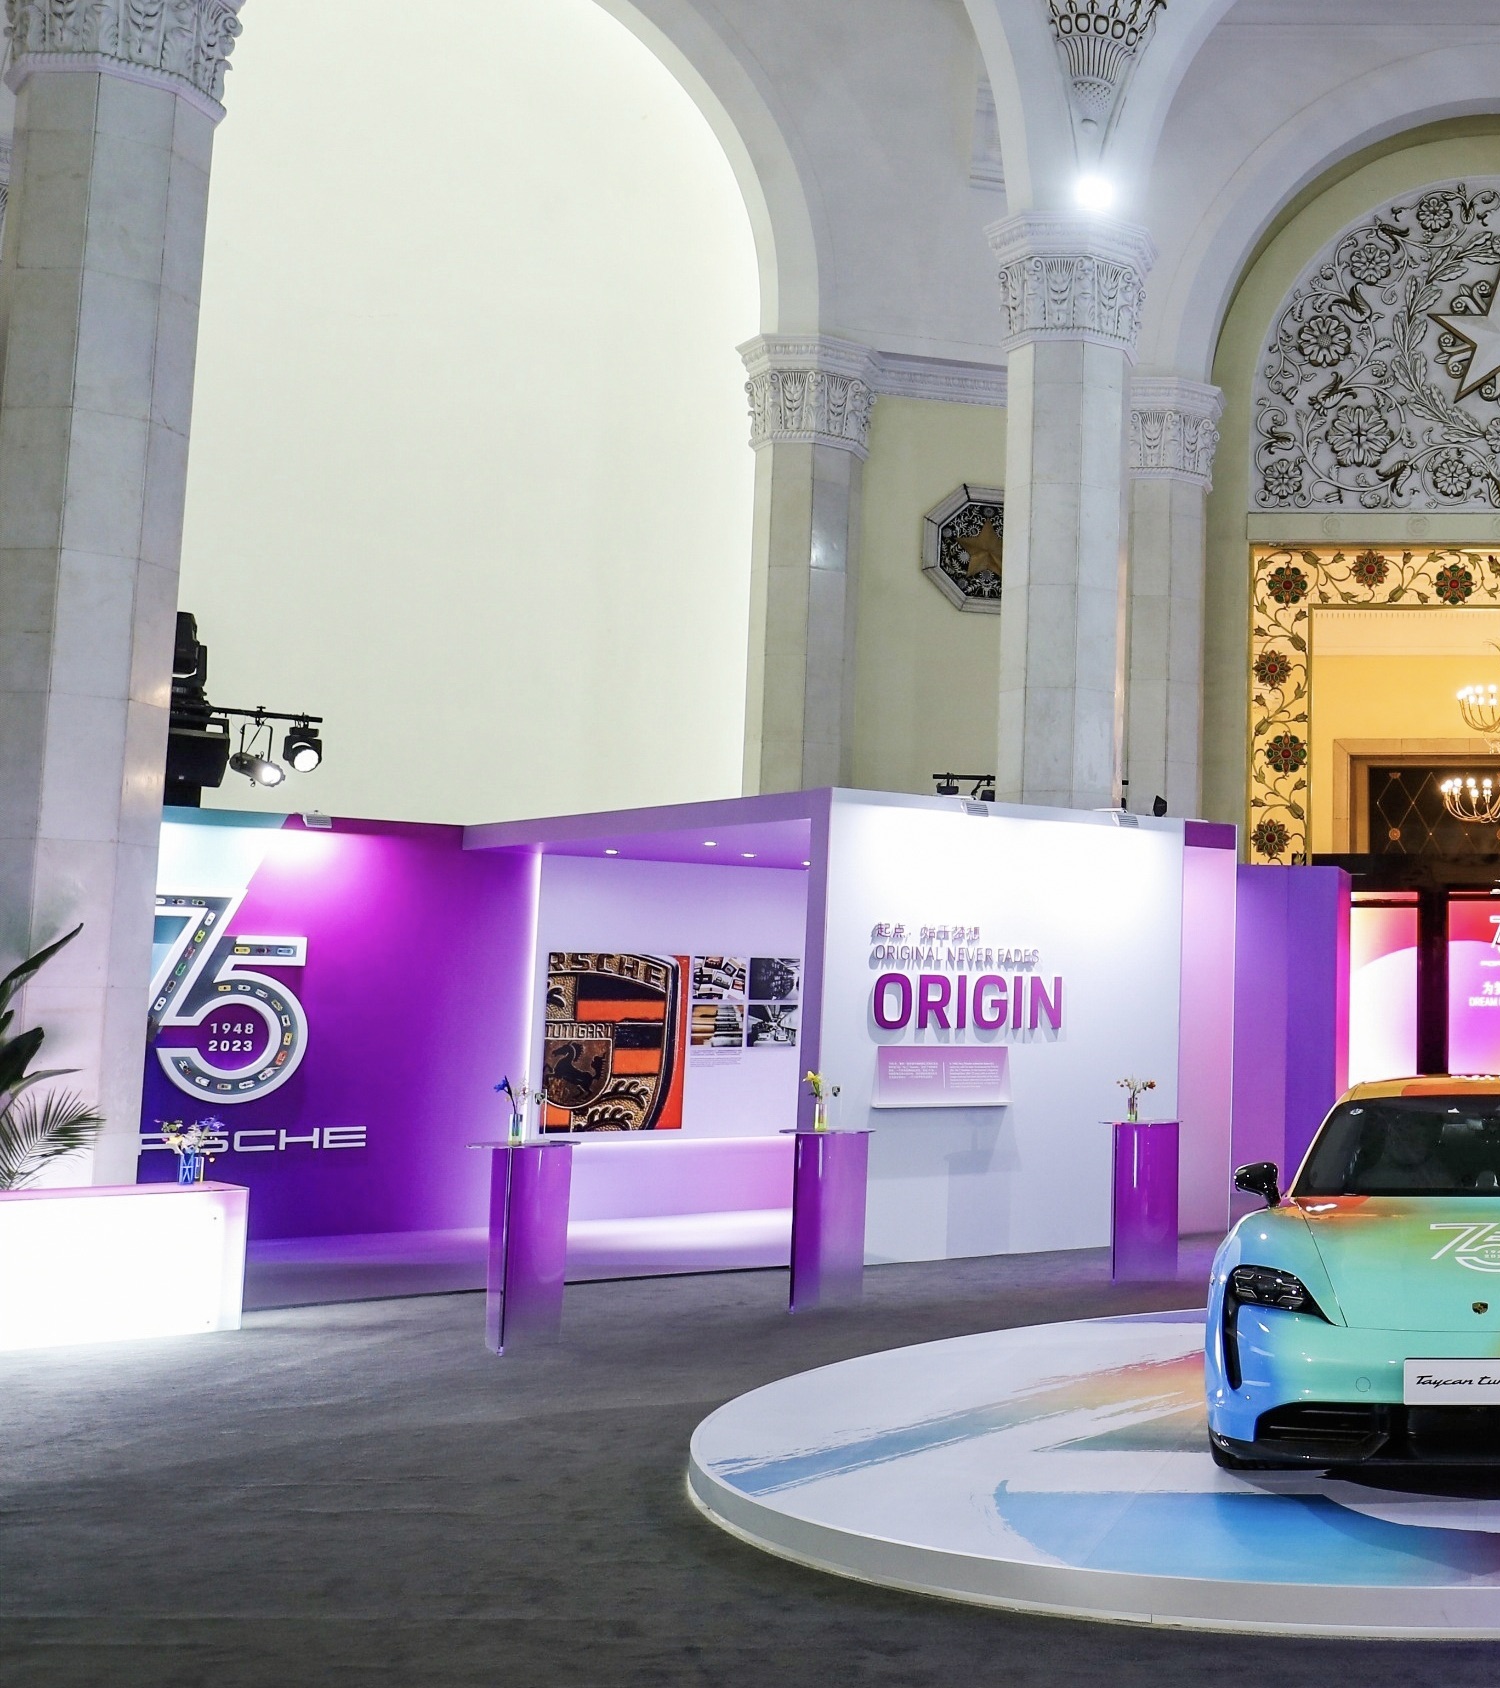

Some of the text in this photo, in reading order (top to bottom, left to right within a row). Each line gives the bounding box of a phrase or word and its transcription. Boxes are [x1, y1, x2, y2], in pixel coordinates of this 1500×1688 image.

[875, 944, 1039, 964] ORIGINAL NEVER FADES
[148, 889, 308, 1103] 75
[873, 972, 1063, 1030] ORIGIN
[1469, 997, 1498, 1006] DREAM
[211, 1023, 254, 1035] 1948
[208, 1040, 253, 1052] 2023
[1416, 1375, 1474, 1389] Taycan
